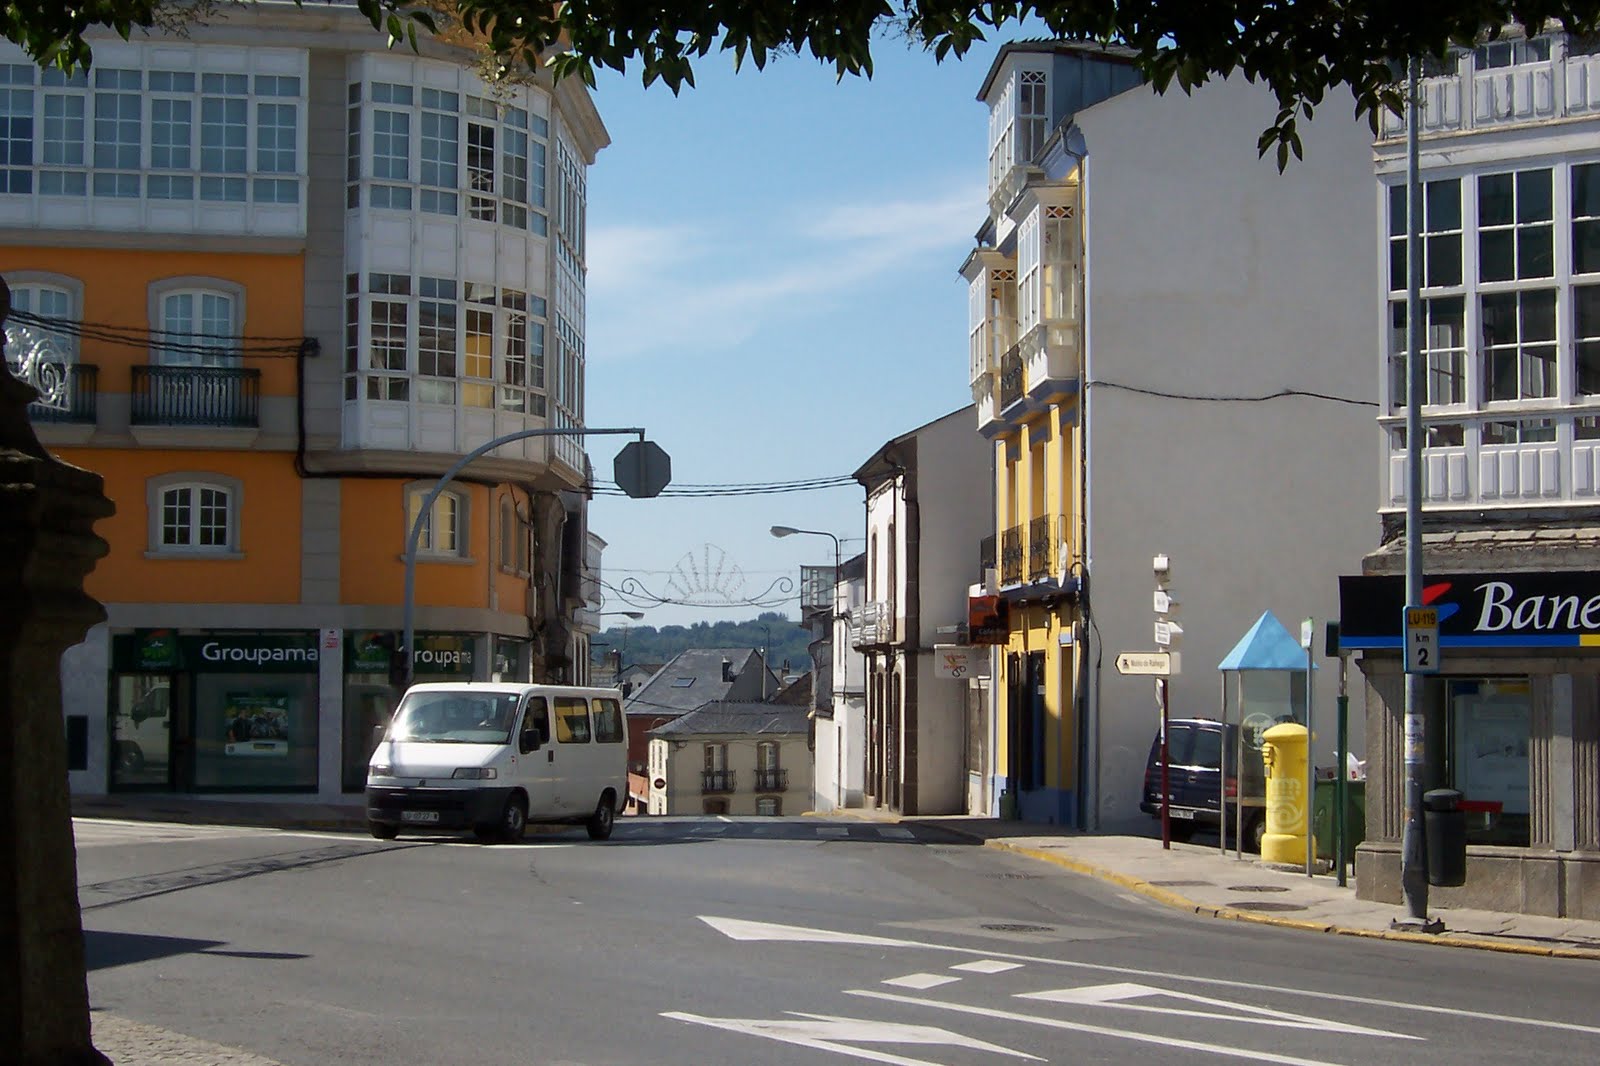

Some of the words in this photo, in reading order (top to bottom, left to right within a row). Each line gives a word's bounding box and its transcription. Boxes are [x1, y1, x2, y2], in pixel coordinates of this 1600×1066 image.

[1472, 581, 1600, 632] Bane
[1408, 611, 1436, 625] LU-119
[1415, 632, 1430, 643] km
[202, 642, 319, 665] Groupama
[414, 651, 472, 667] roupama
[1417, 647, 1429, 666] 2
